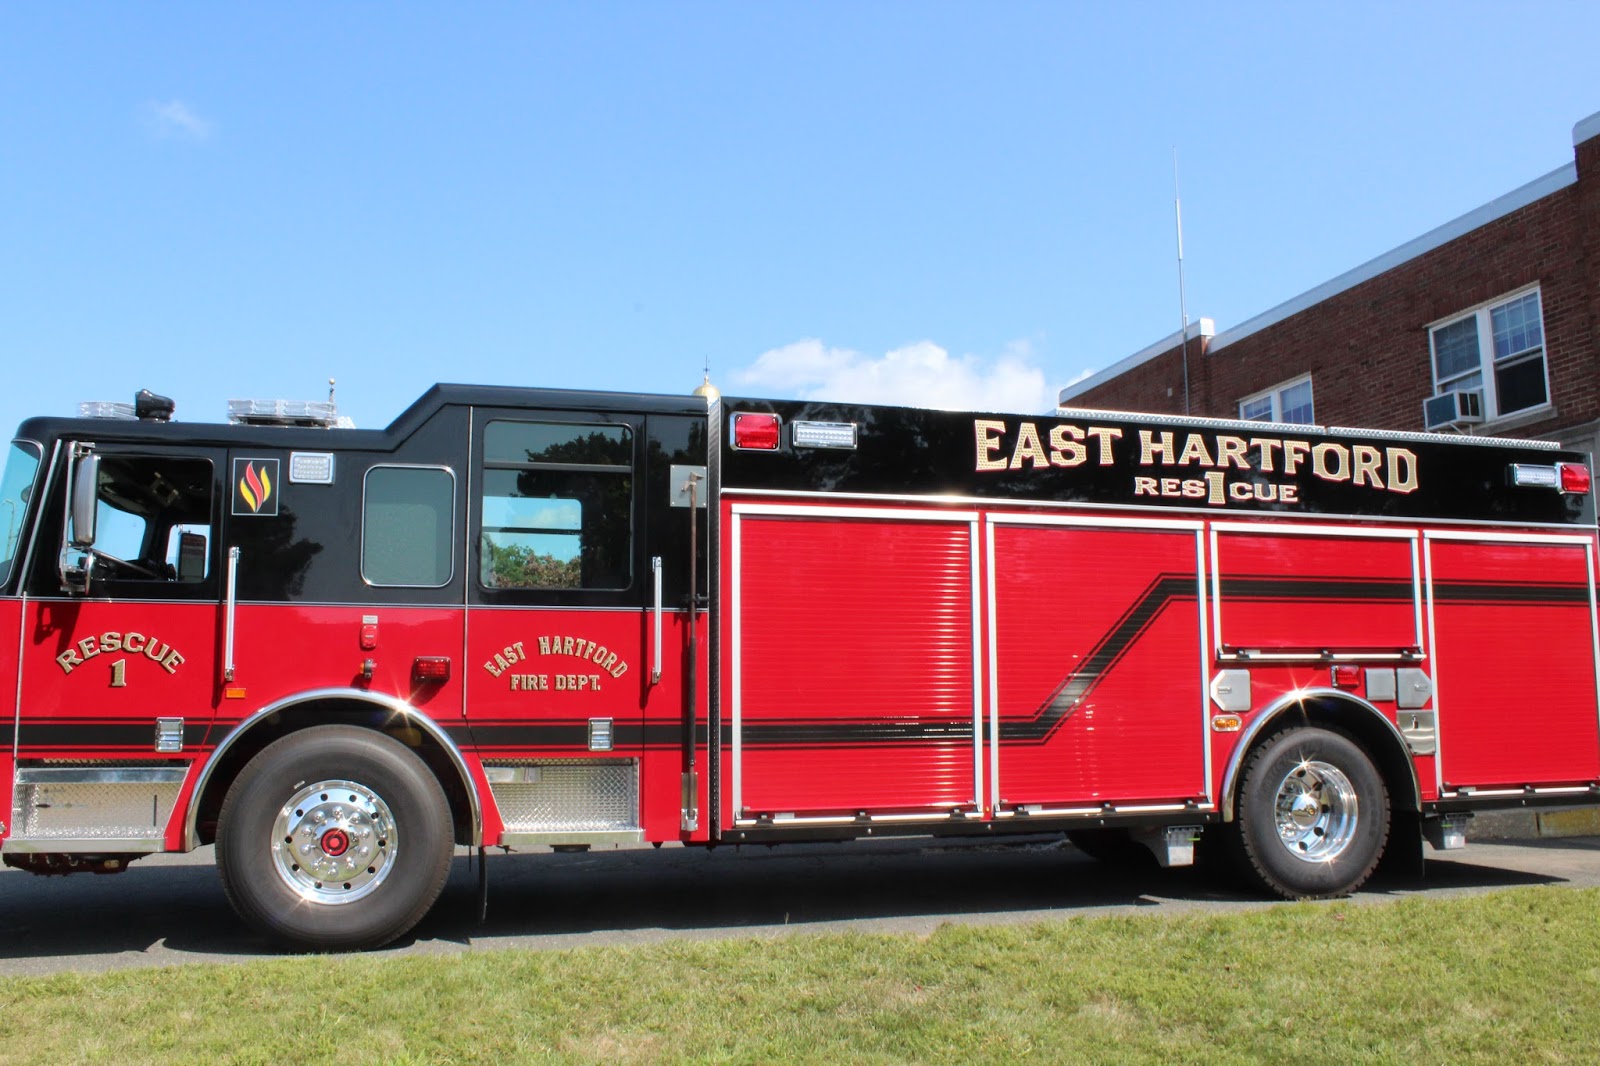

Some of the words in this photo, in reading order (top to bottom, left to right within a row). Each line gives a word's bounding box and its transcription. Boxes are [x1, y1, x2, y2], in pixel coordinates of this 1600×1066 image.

[974, 419, 1123, 472] EAST
[1137, 429, 1419, 494] HARTFORD
[55, 631, 186, 674] RESCUE
[111, 658, 127, 687] 1
[483, 641, 526, 678] EAST
[537, 635, 628, 678] HARTFORD
[510, 674, 548, 691] FIRE
[555, 674, 601, 691] DEPT.
